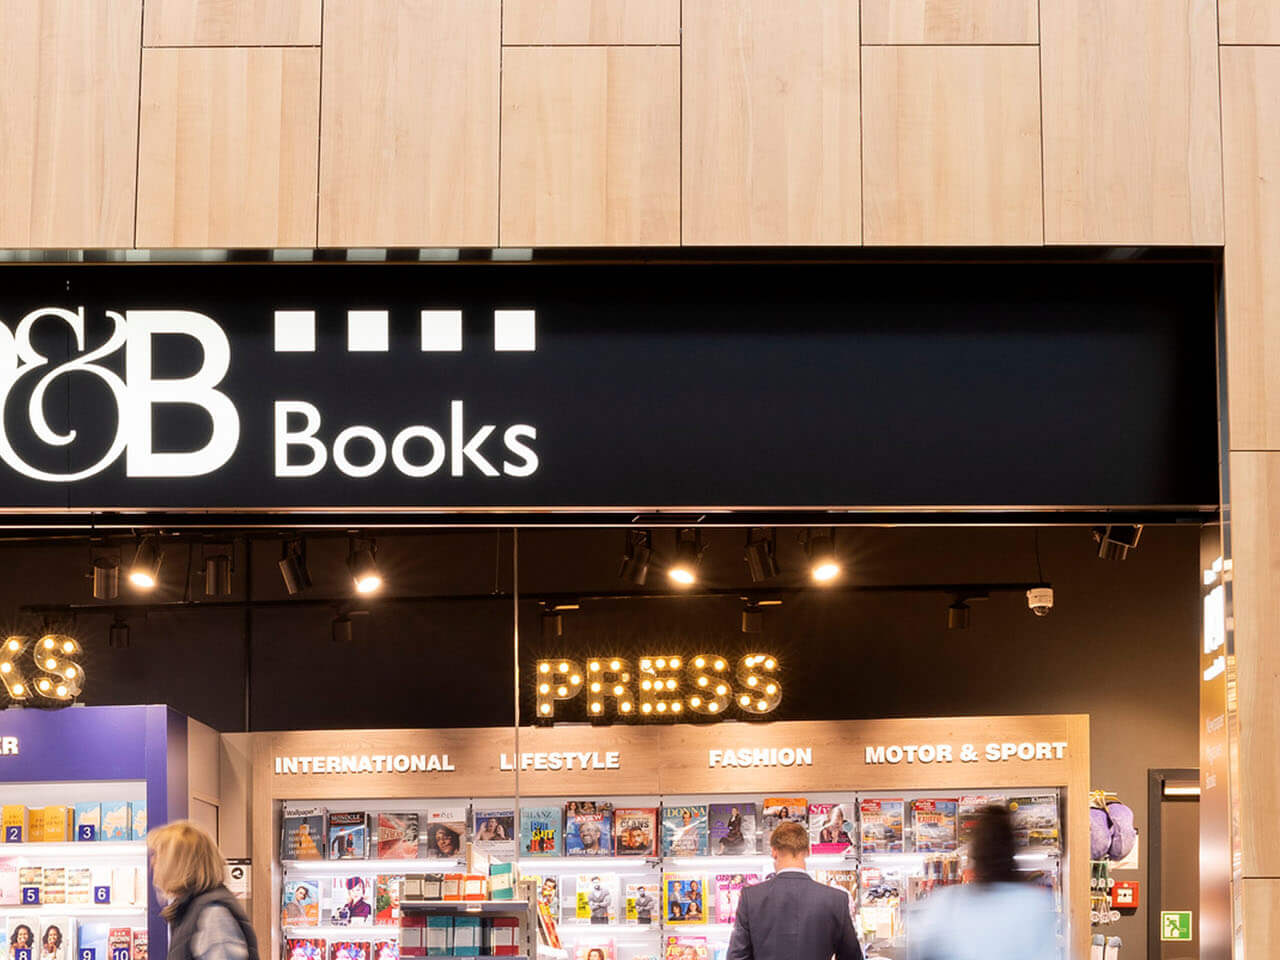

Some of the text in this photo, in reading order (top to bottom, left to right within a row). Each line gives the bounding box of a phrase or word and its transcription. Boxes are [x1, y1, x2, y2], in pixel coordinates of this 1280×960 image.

[275, 399, 540, 478] Books
[536, 654, 783, 718] PRESS
[274, 754, 456, 774] INTERNATIONAL
[500, 751, 620, 771] LIFESTYLE
[708, 747, 813, 768] FASHION
[865, 742, 1069, 766] MOTOR & SPORT
